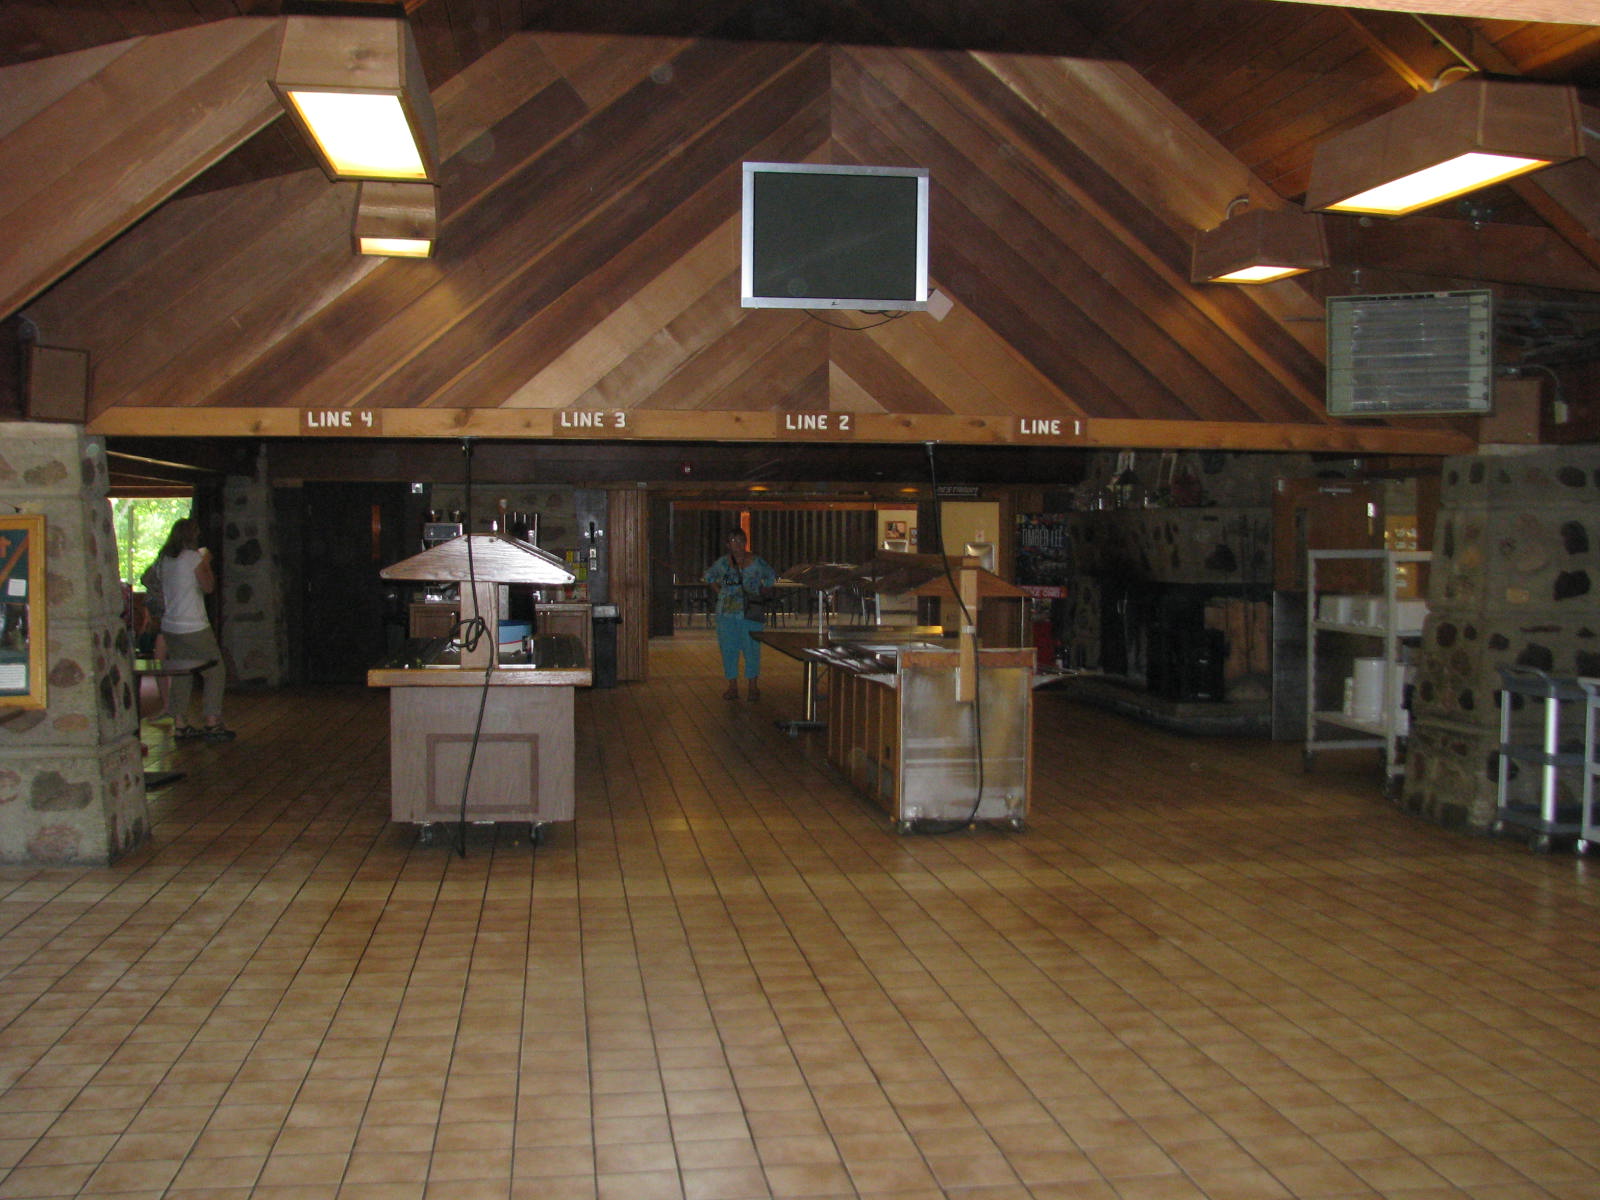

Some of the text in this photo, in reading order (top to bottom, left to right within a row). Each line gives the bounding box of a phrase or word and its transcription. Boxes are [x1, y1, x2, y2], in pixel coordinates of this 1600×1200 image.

[308, 411, 373, 427] LINE 4
[560, 411, 626, 428] LINE 3
[785, 414, 849, 430] LINE 2
[1020, 419, 1080, 435] LINE 1
